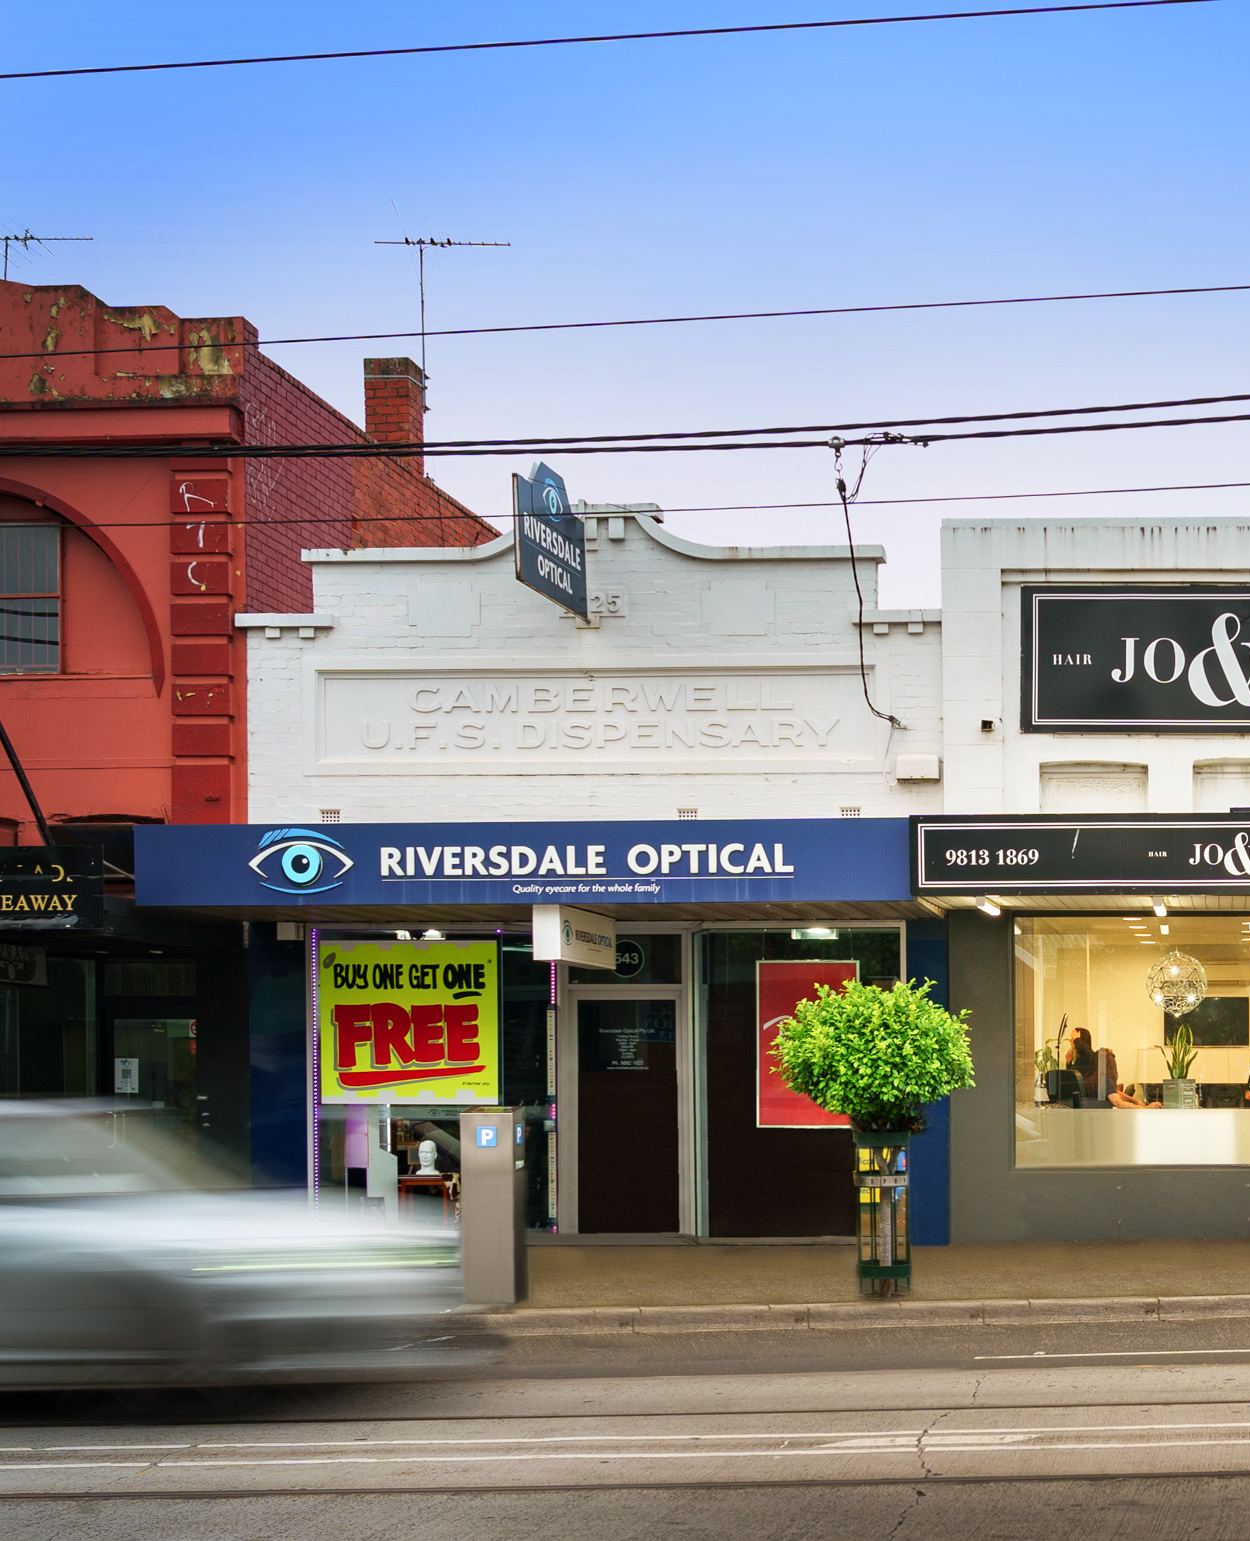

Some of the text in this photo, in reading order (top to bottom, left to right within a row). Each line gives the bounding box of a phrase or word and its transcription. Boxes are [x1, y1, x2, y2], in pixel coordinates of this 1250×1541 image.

[524, 512, 582, 571] RIVERSDALE
[537, 554, 573, 594] OPTICAL
[1052, 654, 1092, 666] HAIR
[408, 681, 794, 714] CAMBERWELL
[360, 716, 841, 750] U.F.S. DISPENSARY
[380, 842, 794, 877] RIVERSDALE OPTICAL
[945, 848, 1040, 866] 9813 1869
[512, 882, 661, 894] Quality eyecare for the whole family
[575, 929, 613, 948] RIVERSDALE OPTICAL
[616, 953, 639, 964] 543
[333, 963, 369, 989] BUY
[372, 964, 404, 990] ONE
[408, 964, 440, 990] GET
[333, 1002, 480, 1069] FREE
